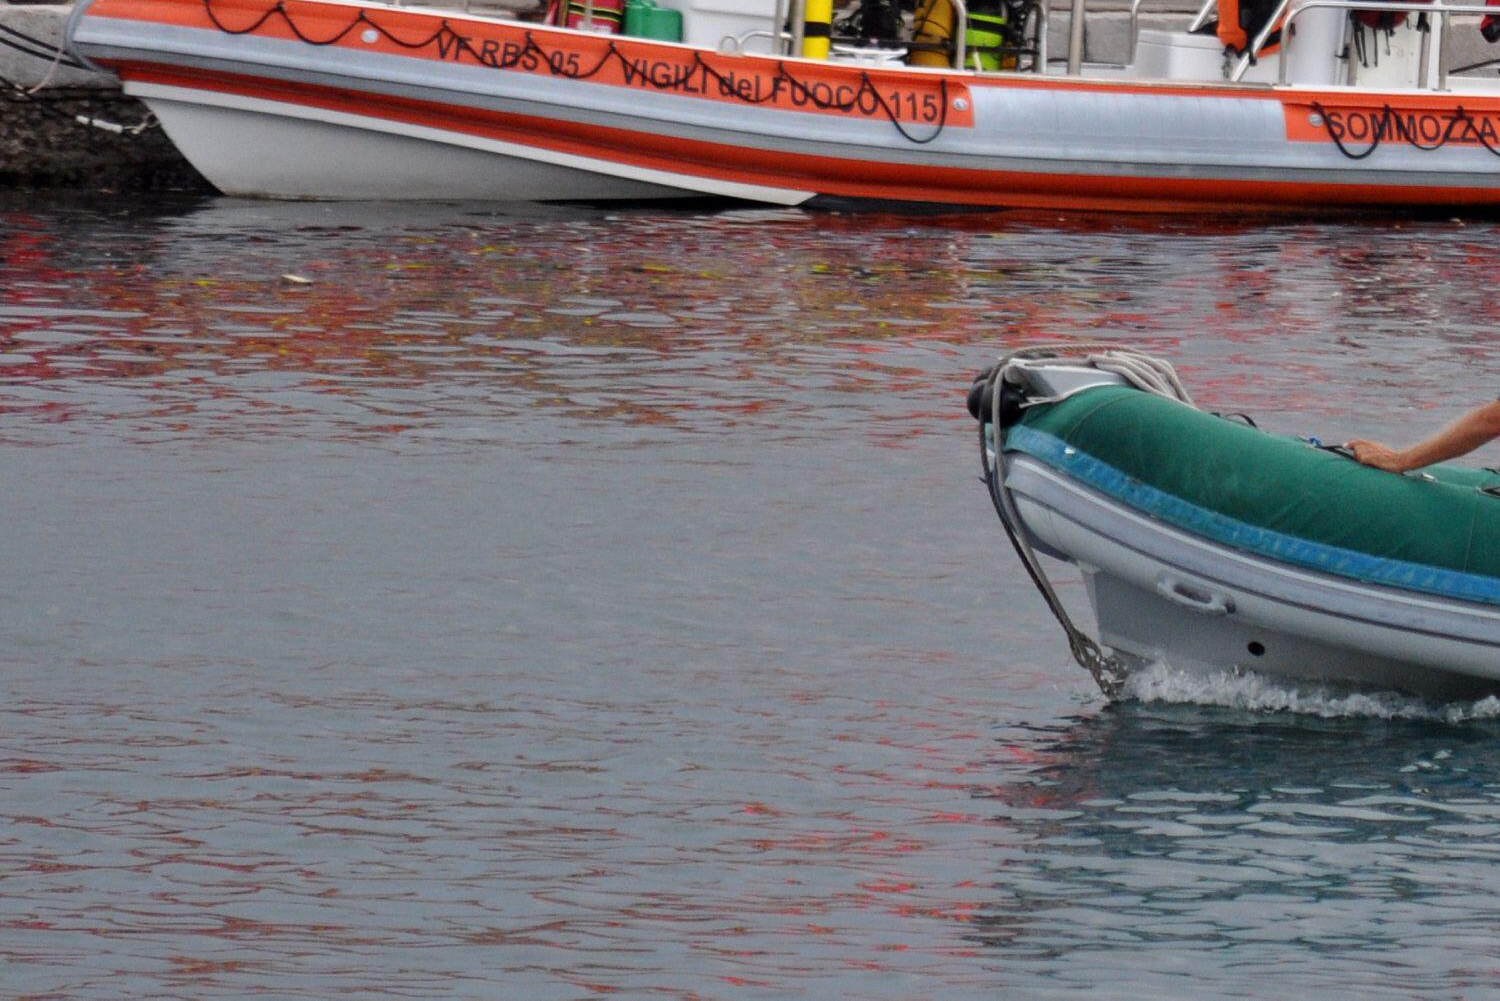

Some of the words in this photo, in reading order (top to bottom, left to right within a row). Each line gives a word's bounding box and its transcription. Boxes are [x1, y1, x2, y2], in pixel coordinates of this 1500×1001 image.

[550, 51, 580, 76] 05
[622, 59, 708, 94] VIGILI
[718, 72, 761, 101] del
[772, 77, 880, 115] FUOCO
[890, 92, 938, 122] 115
